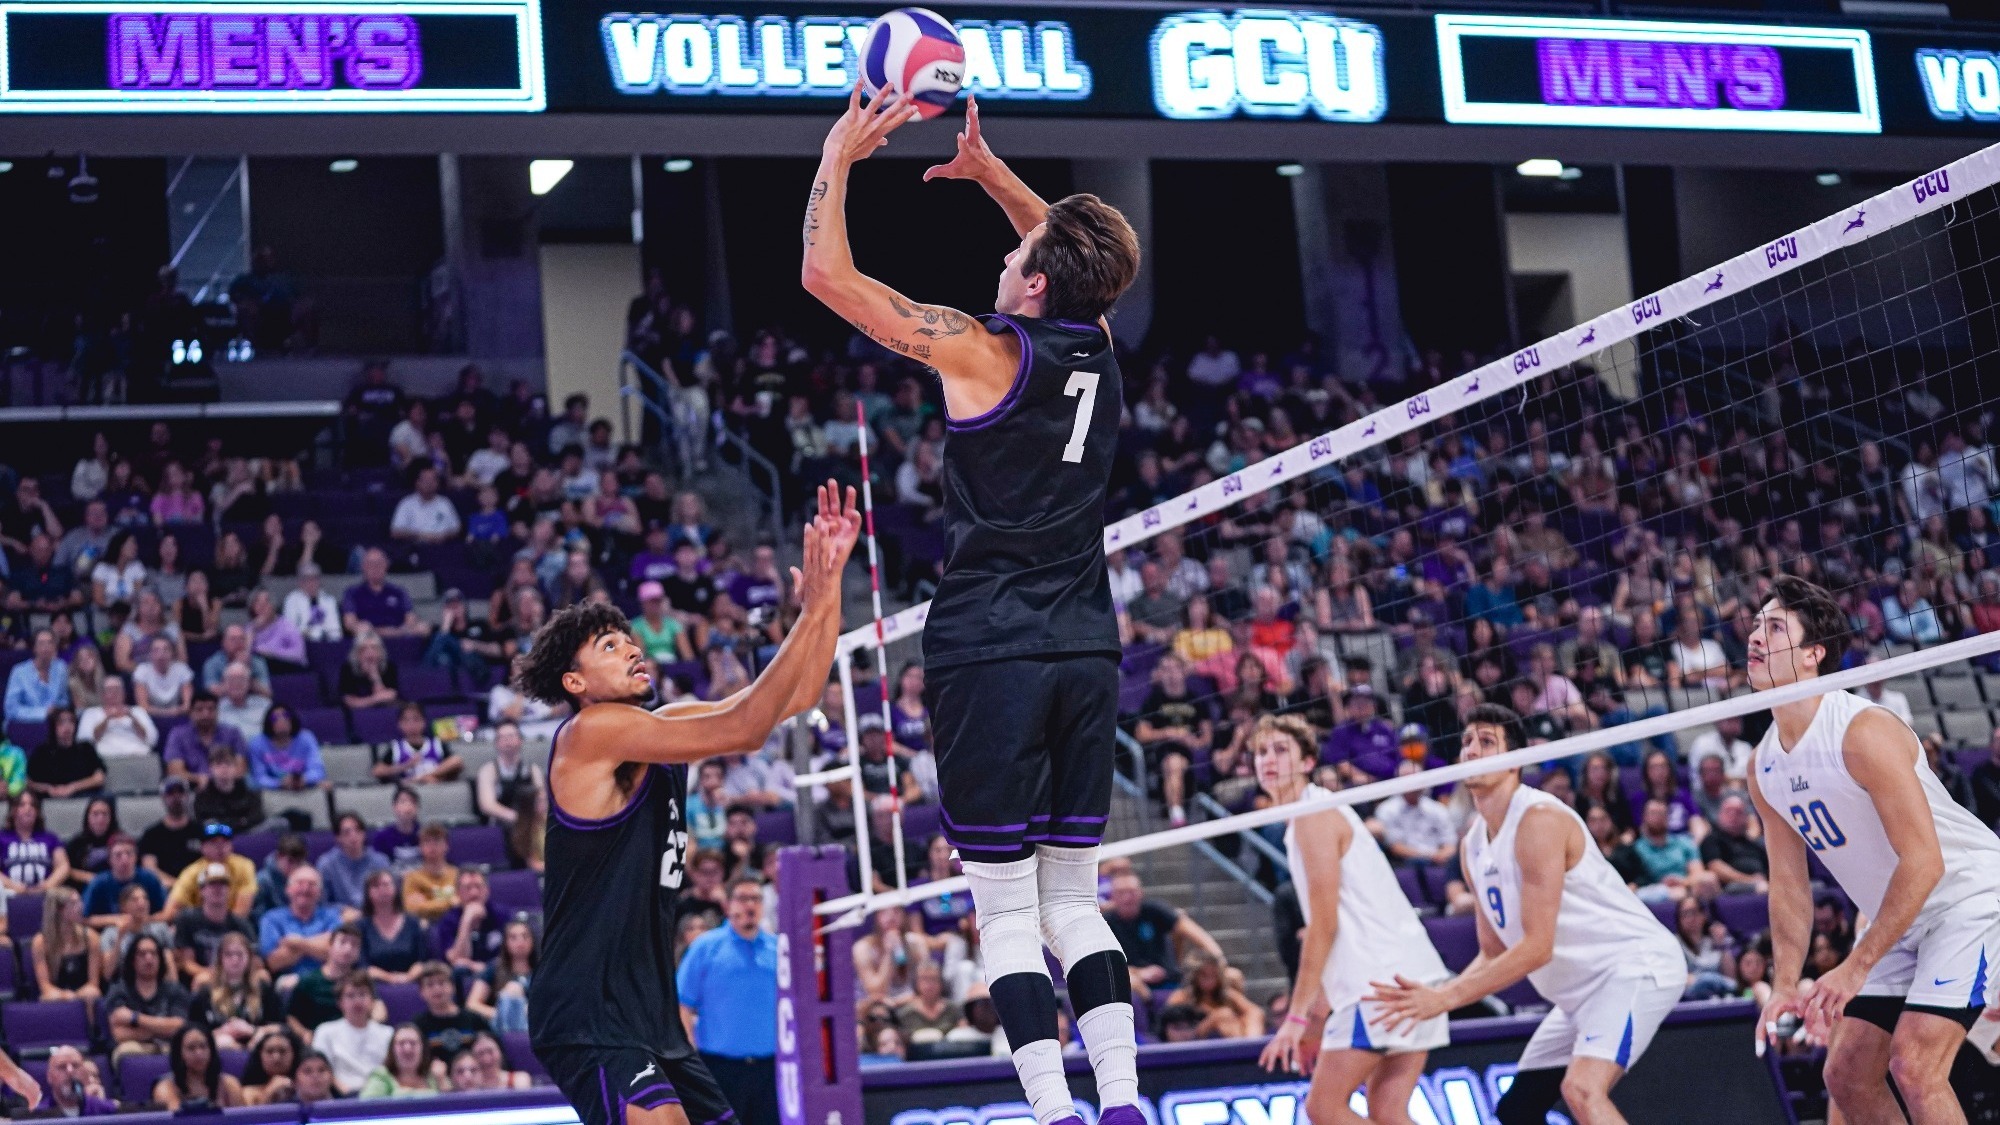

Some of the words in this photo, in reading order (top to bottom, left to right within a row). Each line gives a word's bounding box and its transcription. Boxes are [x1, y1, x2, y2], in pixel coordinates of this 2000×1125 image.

[112, 15, 418, 88] MEN'S
[602, 14, 1089, 98] VOLLEALL
[1152, 10, 1386, 121] GCU
[1540, 38, 1781, 109] MEN'S
[1912, 169, 1949, 203] GCU
[1766, 237, 1797, 268] GCU
[1632, 295, 1661, 324] GCU
[1513, 347, 1540, 374] GCU
[1062, 371, 1100, 463] 7
[1407, 394, 1431, 420] GCU
[1309, 437, 1332, 460] GCU
[1789, 799, 1848, 852] 20
[1487, 886, 1506, 929] 9
